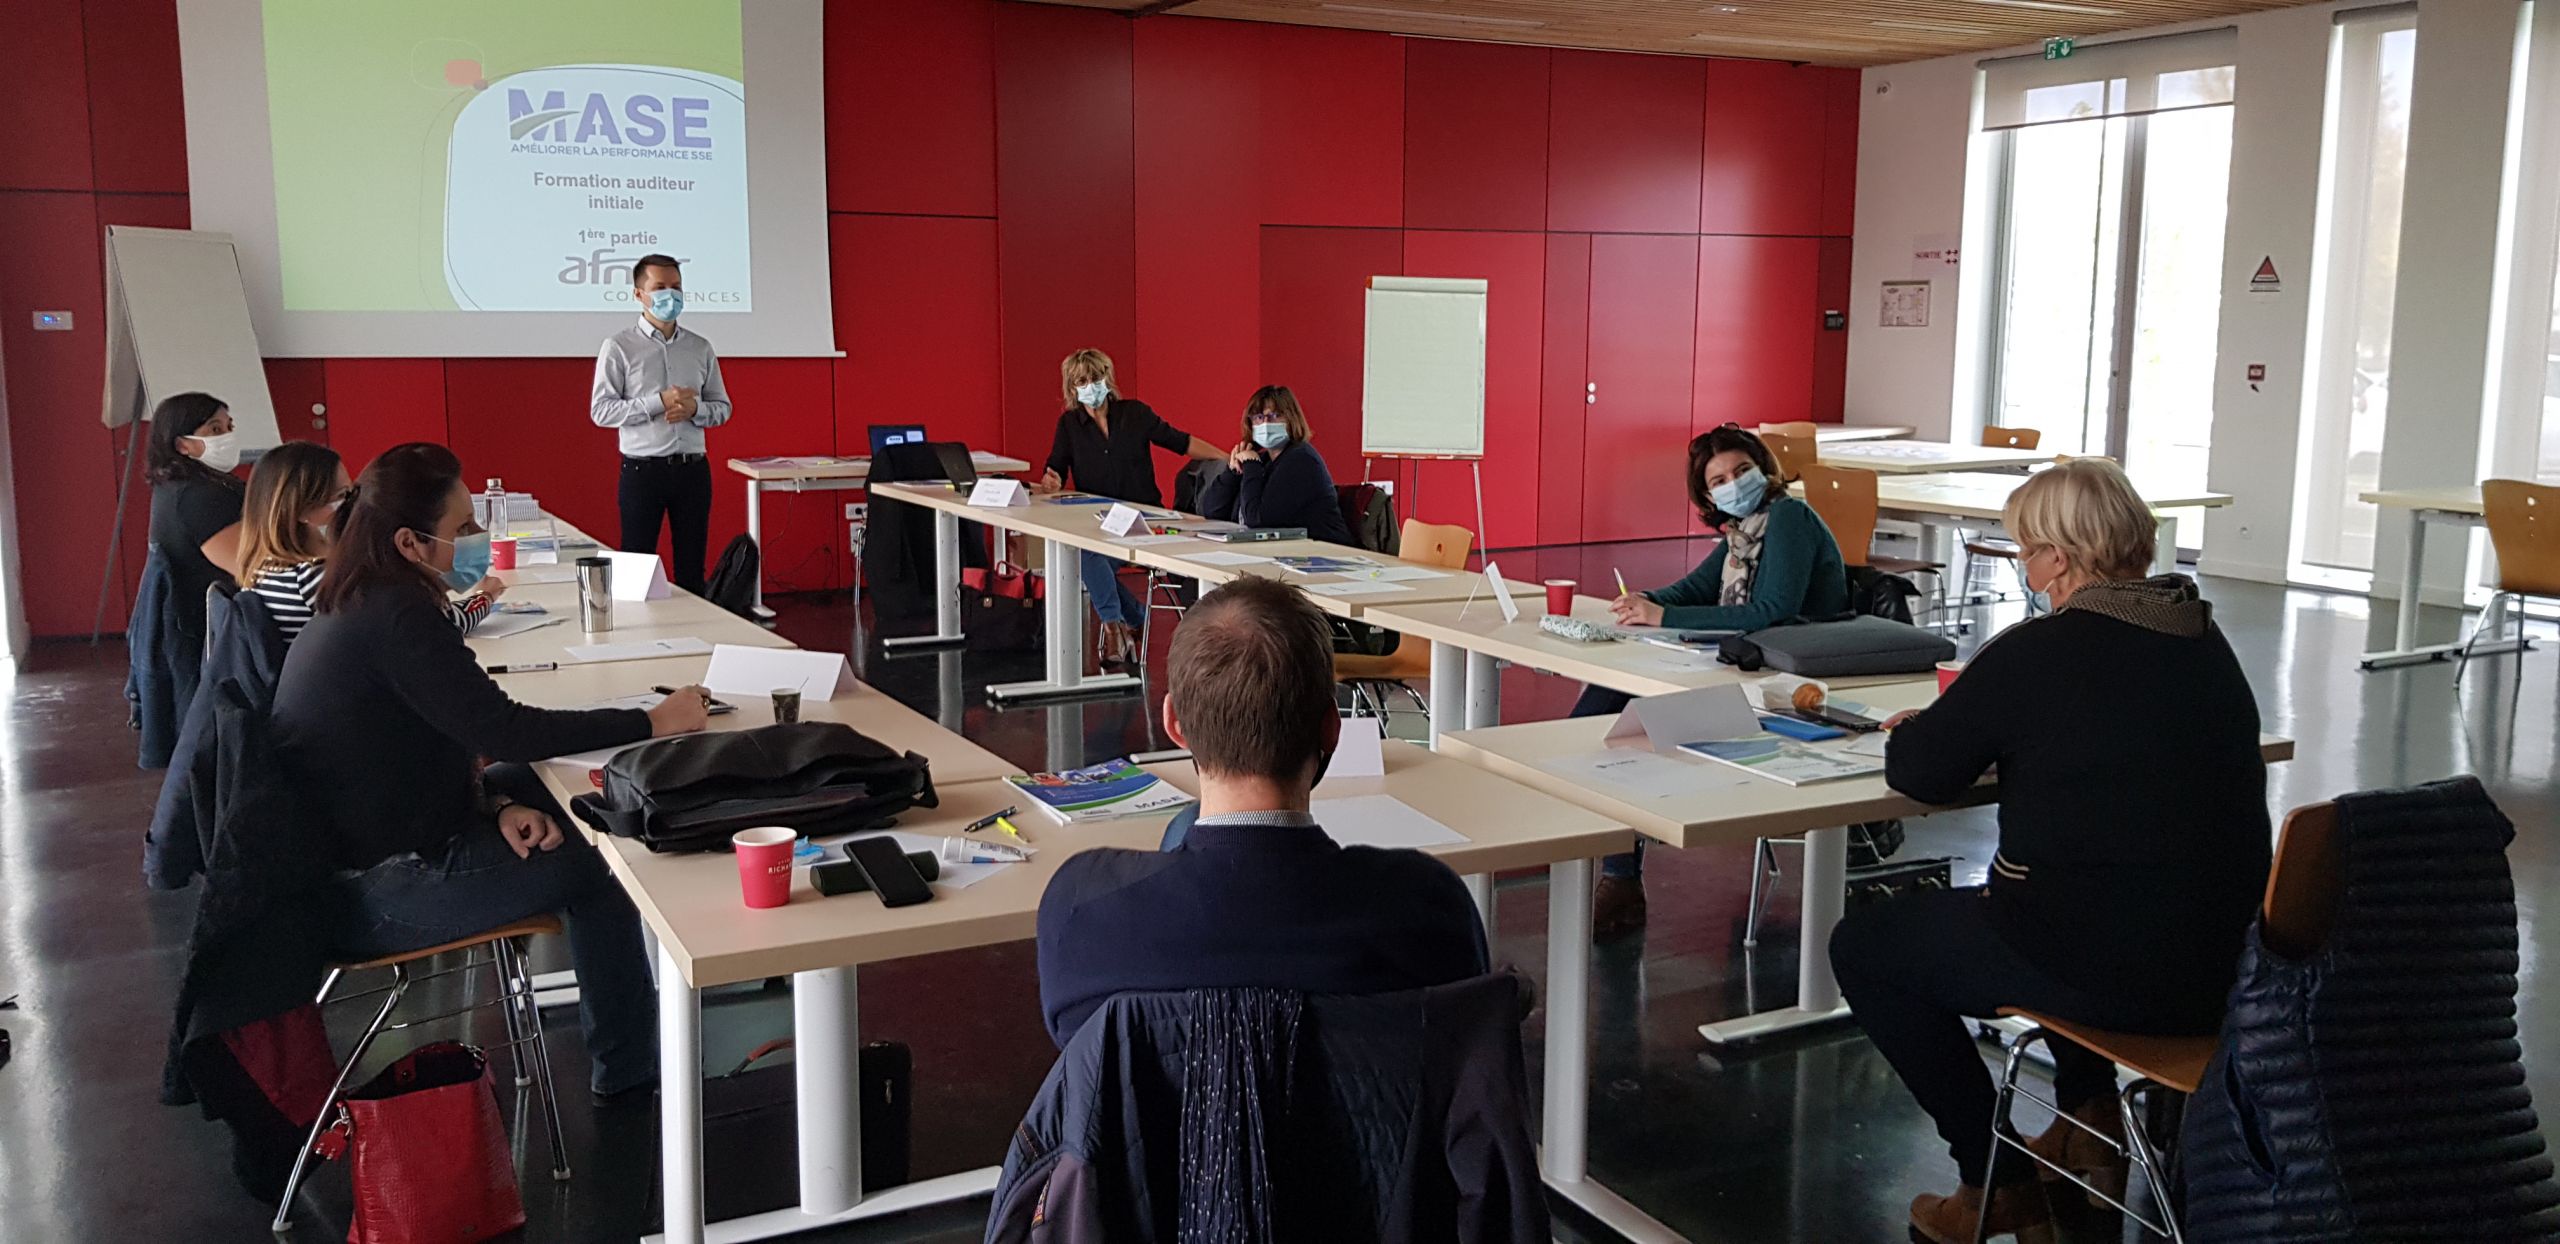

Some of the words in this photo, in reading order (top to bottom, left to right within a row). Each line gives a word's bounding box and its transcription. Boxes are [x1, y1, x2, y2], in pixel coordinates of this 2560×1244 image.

[508, 88, 712, 148] MASE
[511, 142, 580, 156] AMÉLIORER
[583, 147, 599, 156] LA
[602, 147, 689, 160] PERFORMANCE
[691, 150, 713, 161] SSE
[534, 171, 621, 188] Formation
[626, 175, 695, 191] auditeur
[589, 195, 644, 210] initiale
[578, 228, 605, 244] 1ère
[611, 231, 658, 247] partie
[603, 290, 740, 303] COENCES
